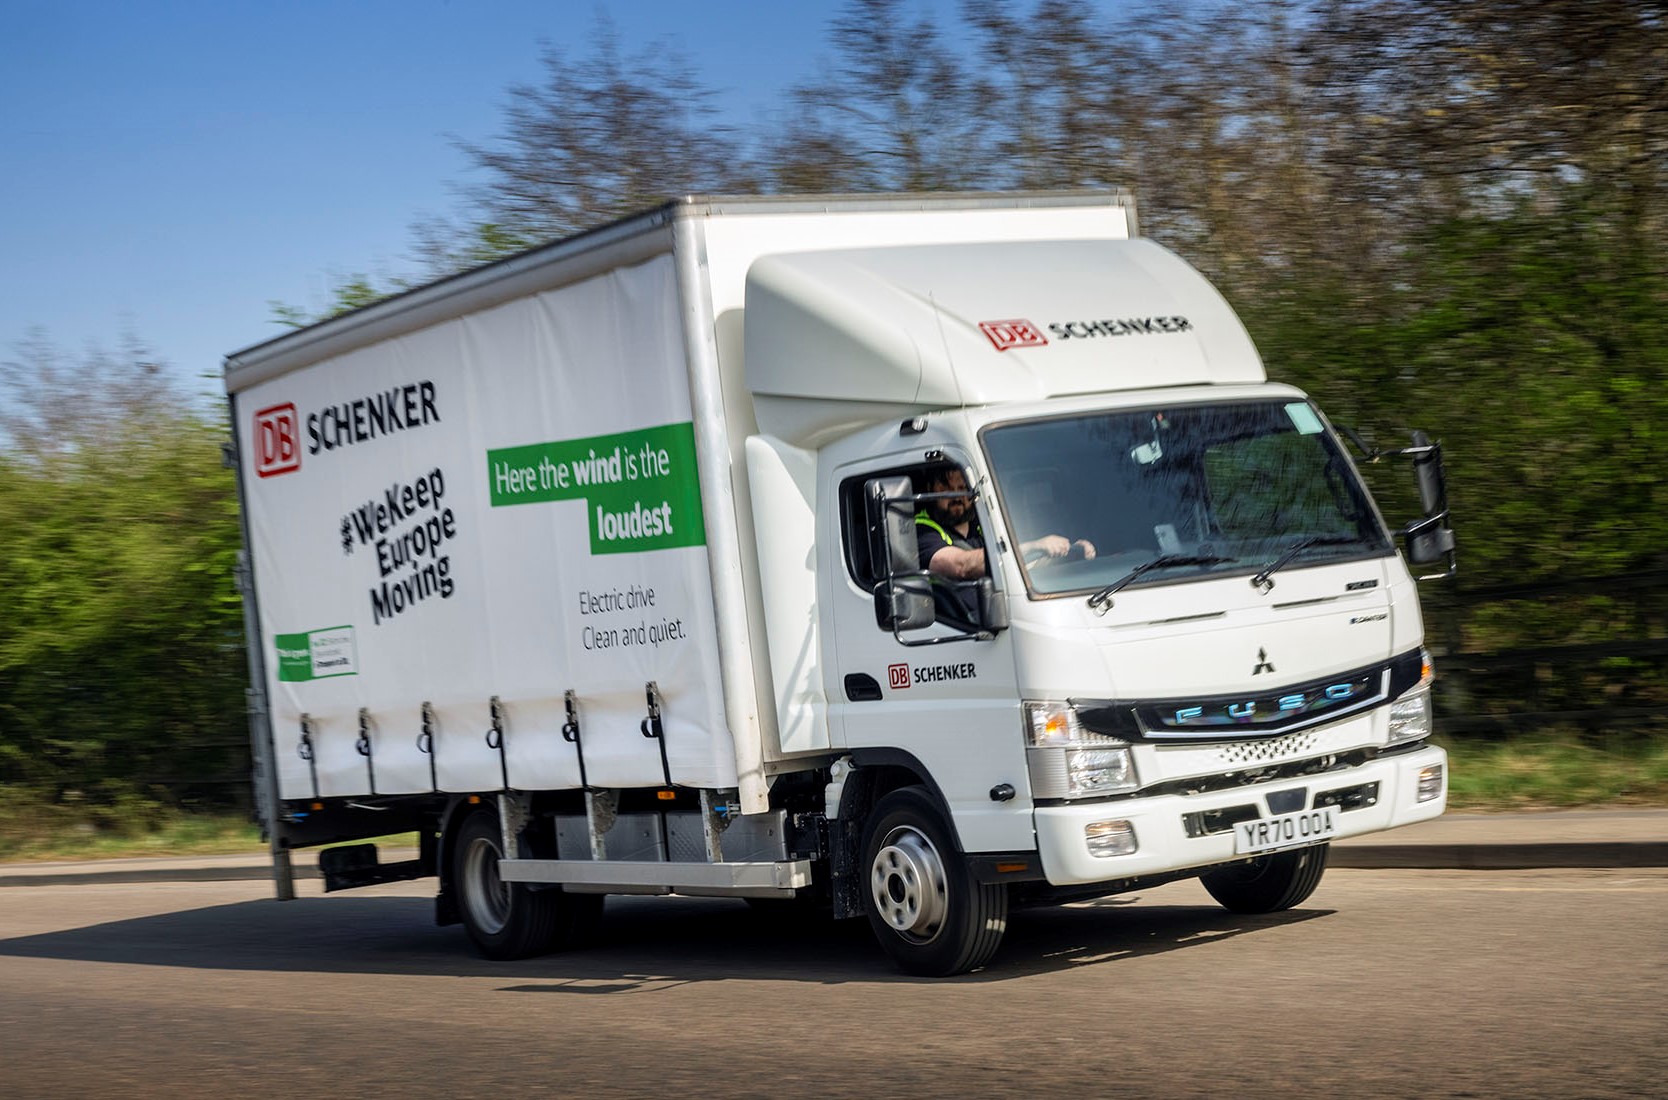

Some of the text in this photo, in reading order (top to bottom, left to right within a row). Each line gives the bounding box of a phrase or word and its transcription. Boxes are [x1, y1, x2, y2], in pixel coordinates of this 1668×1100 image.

[989, 316, 1193, 344] DB SCHENKER
[261, 380, 440, 466] DB SCHENKER
[495, 442, 670, 494] Here the wind is the
[340, 467, 445, 555] #WeKeep
[596, 501, 673, 541] loudest
[375, 508, 456, 578] Europe
[369, 556, 455, 626] Moving
[579, 584, 656, 615] Electric drive
[582, 617, 686, 651] Clean and quiet.
[890, 663, 977, 685] DB SCHENKER
[1175, 683, 1354, 725] FUSO
[1244, 818, 1294, 847] YR70
